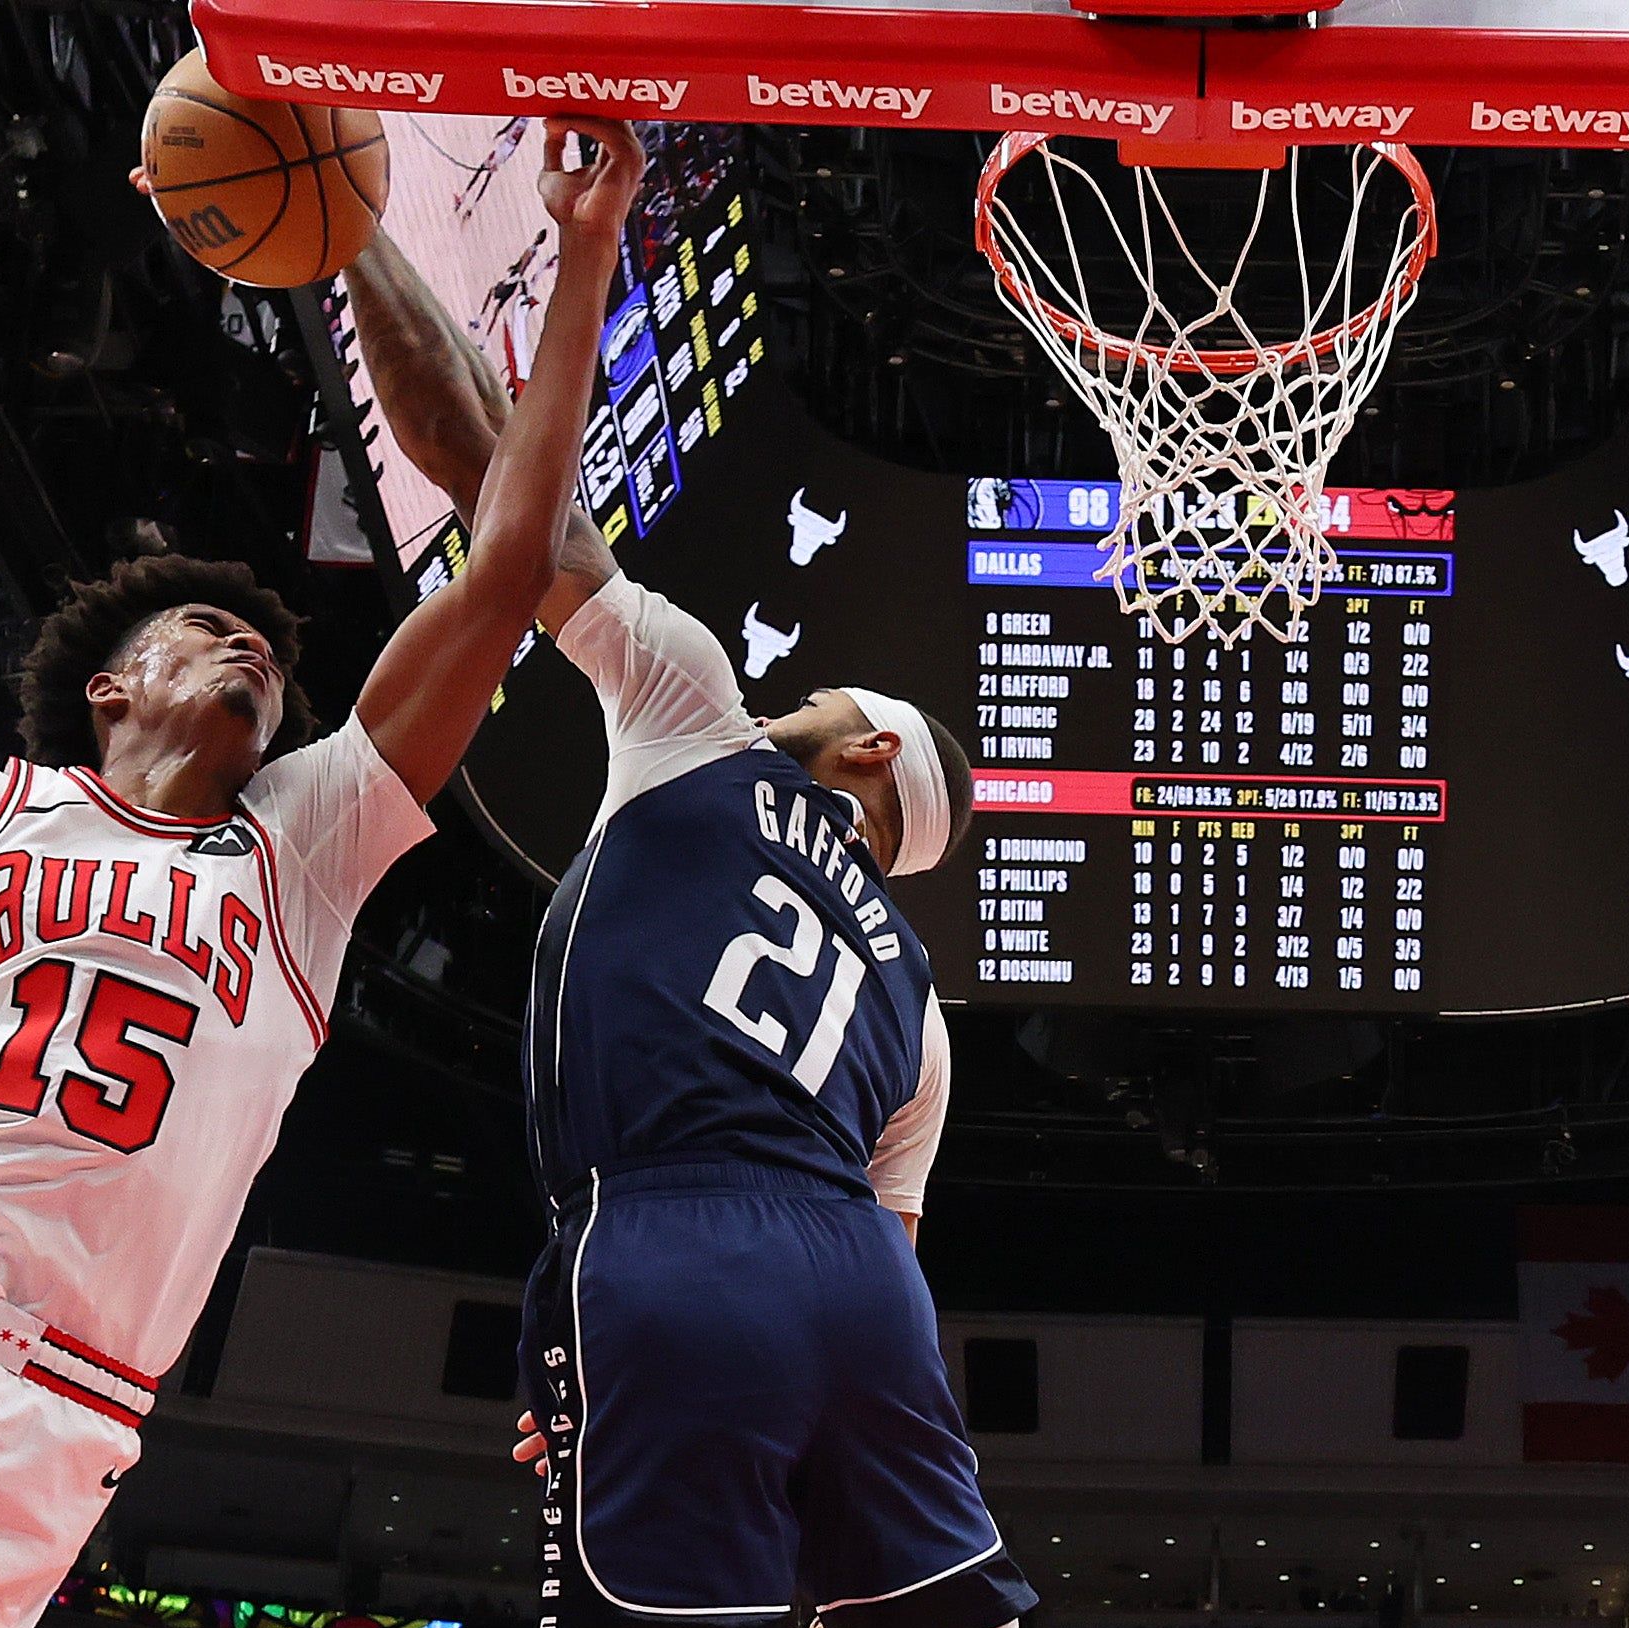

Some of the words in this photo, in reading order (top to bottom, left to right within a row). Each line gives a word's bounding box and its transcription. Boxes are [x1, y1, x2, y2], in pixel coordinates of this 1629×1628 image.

[257, 55, 444, 103] betway
[503, 68, 689, 111] betway
[747, 75, 932, 119] betway
[990, 83, 1174, 134] betway
[1230, 100, 1414, 137] betway
[1068, 487, 1109, 527] 98
[974, 552, 1042, 576] DALLAS
[1348, 565, 1367, 582] FT:
[1001, 613, 1051, 635] GREEN
[979, 643, 998, 665] 10
[1001, 644, 1085, 668] HARDAWAY
[1086, 646, 1113, 668] JR.
[978, 675, 997, 696] 21
[1001, 675, 1069, 698] GAFFORD
[977, 705, 997, 727] 77
[1001, 706, 1058, 728] DONCIC
[981, 736, 997, 758] 11
[1001, 737, 1053, 759] IRVING
[973, 780, 1053, 803] CHICAGO
[1236, 789, 1263, 805] 3PT:
[1342, 792, 1361, 809] FT:
[1173, 821, 1181, 837] F
[1197, 822, 1222, 838] PTS
[1284, 823, 1300, 838] FG
[1340, 824, 1364, 840] 3PT
[1403, 826, 1419, 841] FT
[986, 838, 997, 861] 3
[1000, 838, 1086, 862] DRUMMOND
[755, 780, 901, 962] GAFFORD
[978, 869, 997, 891] 15
[1000, 869, 1068, 892] PHILLIPS
[979, 899, 996, 921] 17
[1000, 899, 1044, 922] BITIM
[1000, 929, 1049, 952] WHITE
[978, 959, 996, 981] 12
[1000, 960, 1072, 982] DOSUNMU
[703, 874, 867, 1097] 21
